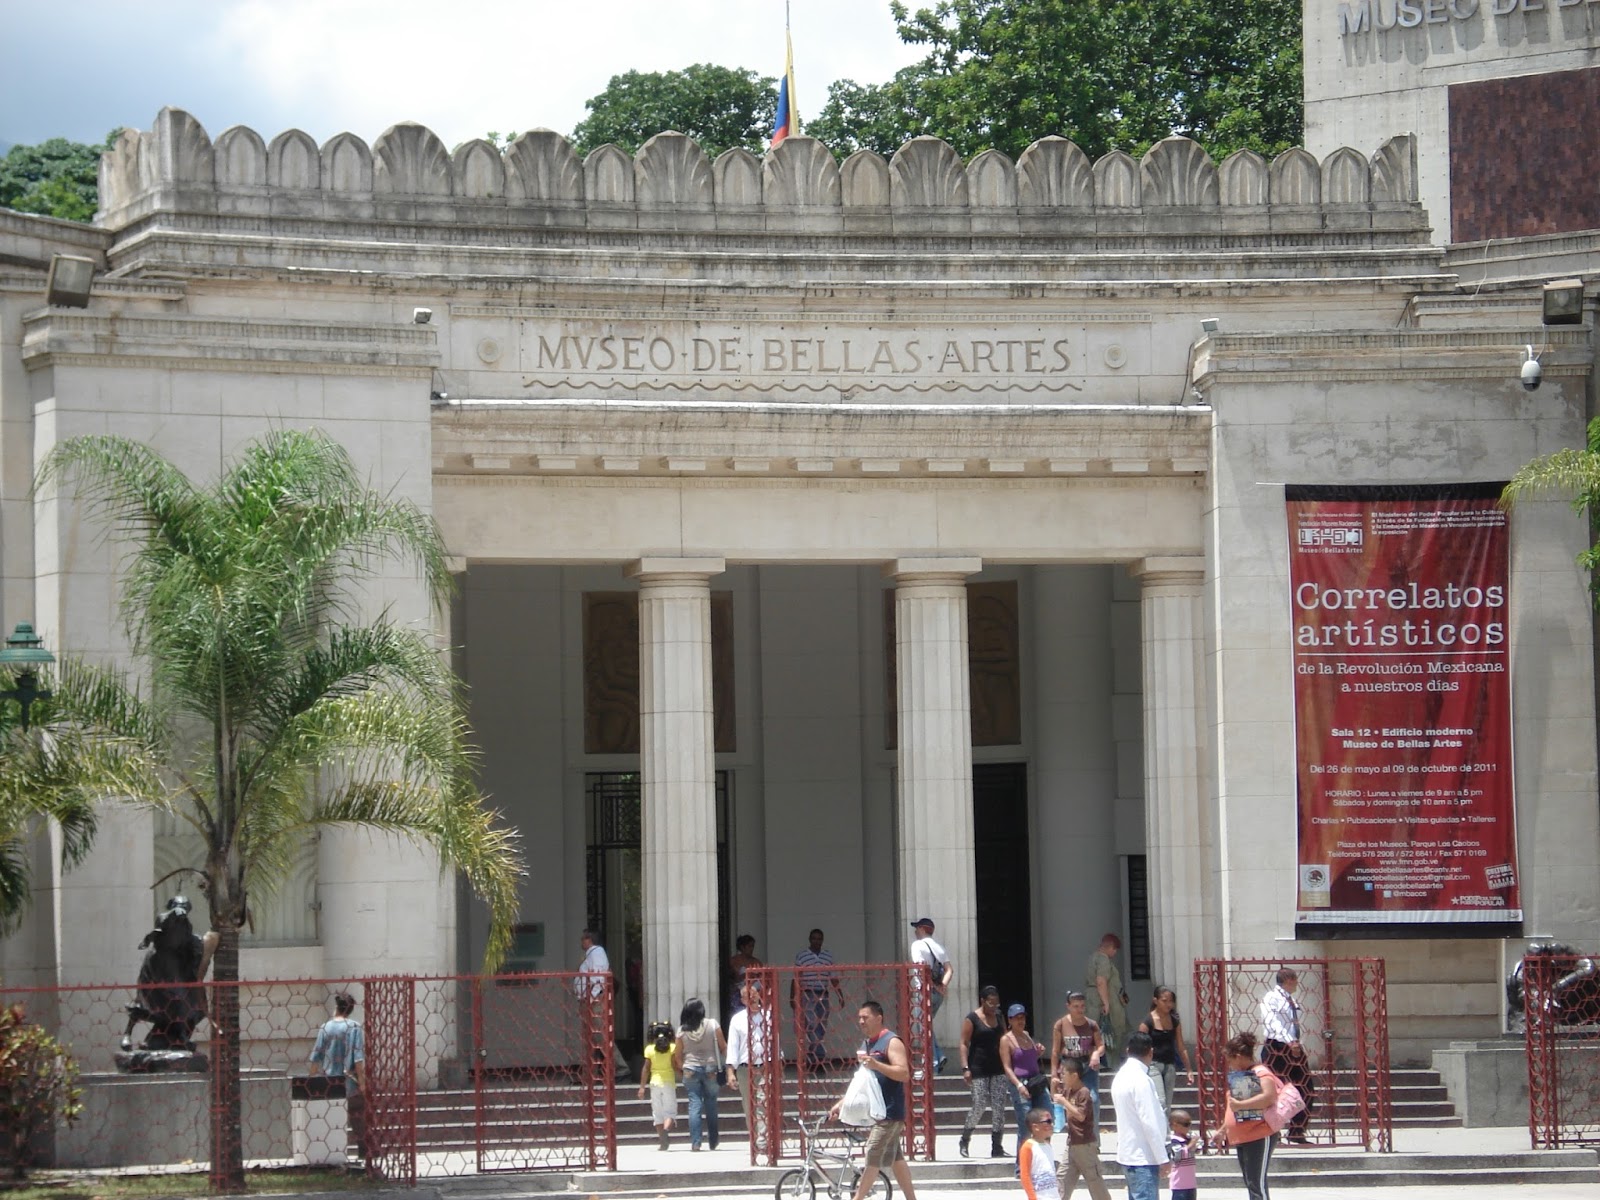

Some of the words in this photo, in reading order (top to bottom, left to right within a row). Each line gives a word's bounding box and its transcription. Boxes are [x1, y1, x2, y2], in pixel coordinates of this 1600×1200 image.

[1337, 0, 1479, 35] MUSEO
[692, 338, 741, 372] DE
[763, 337, 922, 373] BELLAS
[937, 338, 1072, 374] ARTES
[1297, 582, 1504, 610] Correlatos
[1298, 619, 1504, 646] artísticos
[1298, 662, 1315, 674] de
[1319, 662, 1334, 674] la
[1336, 661, 1424, 674] Revolución
[1427, 661, 1504, 674] Mexicana
[1342, 684, 1351, 692] a
[1354, 680, 1423, 692] nuestros
[1427, 679, 1459, 692] días
[1332, 728, 1354, 736] Sala
[1358, 728, 1371, 736] 12
[1382, 728, 1422, 736] Edificio
[1426, 728, 1474, 736] moderno
[1343, 740, 1378, 748] Museo
[1380, 740, 1394, 748] de
[1398, 740, 1430, 748] Bellas
[1433, 739, 1462, 748] Artes
[1310, 764, 1325, 773] Del
[1326, 764, 1338, 773] 26
[1340, 764, 1352, 773] de
[1355, 766, 1380, 775] mayo
[1393, 765, 1404, 773] 09
[1407, 764, 1419, 772] de
[1421, 764, 1457, 772] octubre
[1460, 764, 1472, 772] de
[1474, 764, 1497, 772] 2011
[1373, 799, 1409, 807] domingos
[1430, 816, 1460, 825] guiadas
